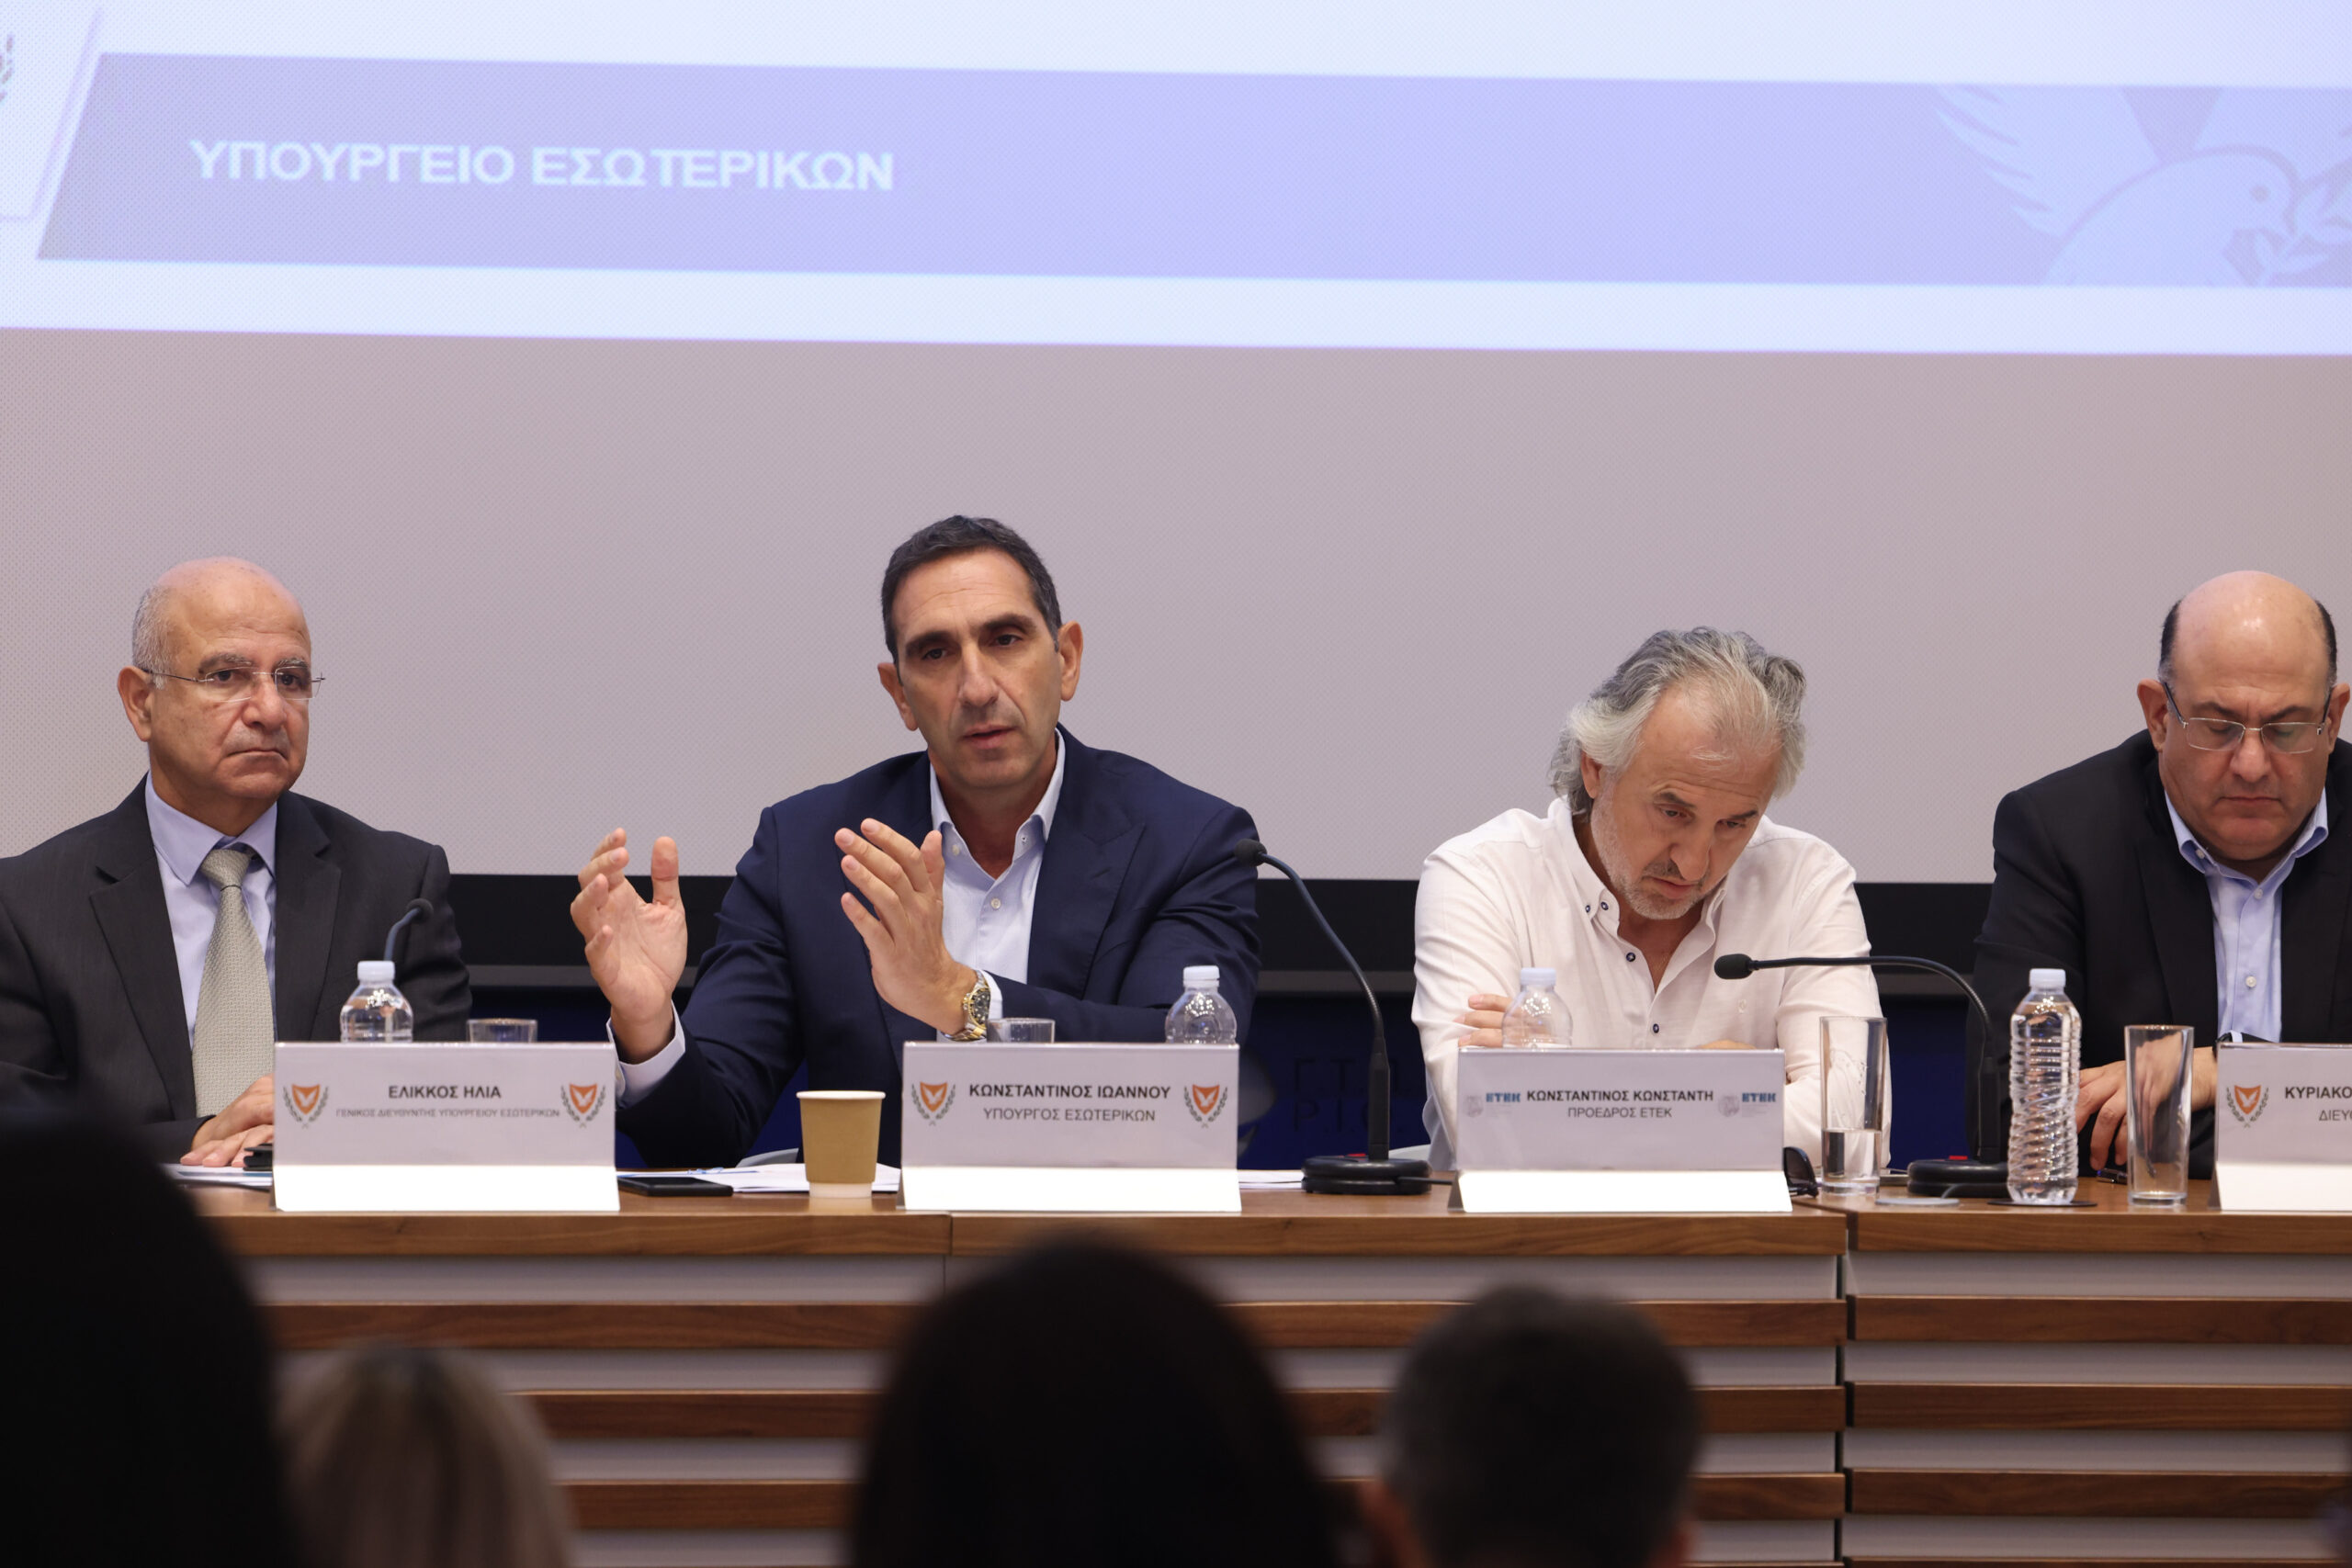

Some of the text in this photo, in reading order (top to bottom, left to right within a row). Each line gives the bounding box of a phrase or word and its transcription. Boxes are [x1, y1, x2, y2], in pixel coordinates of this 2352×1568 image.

[188, 140, 894, 191] ΥΠΟΥΡΓΕΙΟ ΕΣΩΤΕΡΙΚΩΝ
[388, 1085, 502, 1099] ΕΛΙΚΚΟΣ ΗΛΙΑ
[969, 1084, 1170, 1100] ΚΩΝΣΤΑΝΤΙΝΟΣ ΙΩΑΝΝΟΥ
[1526, 1089, 1713, 1101] ΚΩΝΣΤΑΝΤΙΝΟΣ ΚΩΝΣΤΑΝΤΗ
[2285, 1086, 2352, 1100] ΚΥΡΙΑΚΟ
[335, 1108, 560, 1118] ΓΕΝΙΚΟΣ ΔΙΕΥΘΥΝΤΗΣ ΥΠΟΥΡΓΕΙΟΥ ΕΣΩΤΕΡΙΚΩΝ
[983, 1107, 1156, 1122] ΥΠΟΥΡΓΟΣ ΕΣΩΤΕΡΙΚΩΝ
[1567, 1107, 1672, 1118] ΠΡΟΕΔΡΟΣ ΕΤΕΚ
[2318, 1109, 2352, 1122] ΔΙΕΥ
